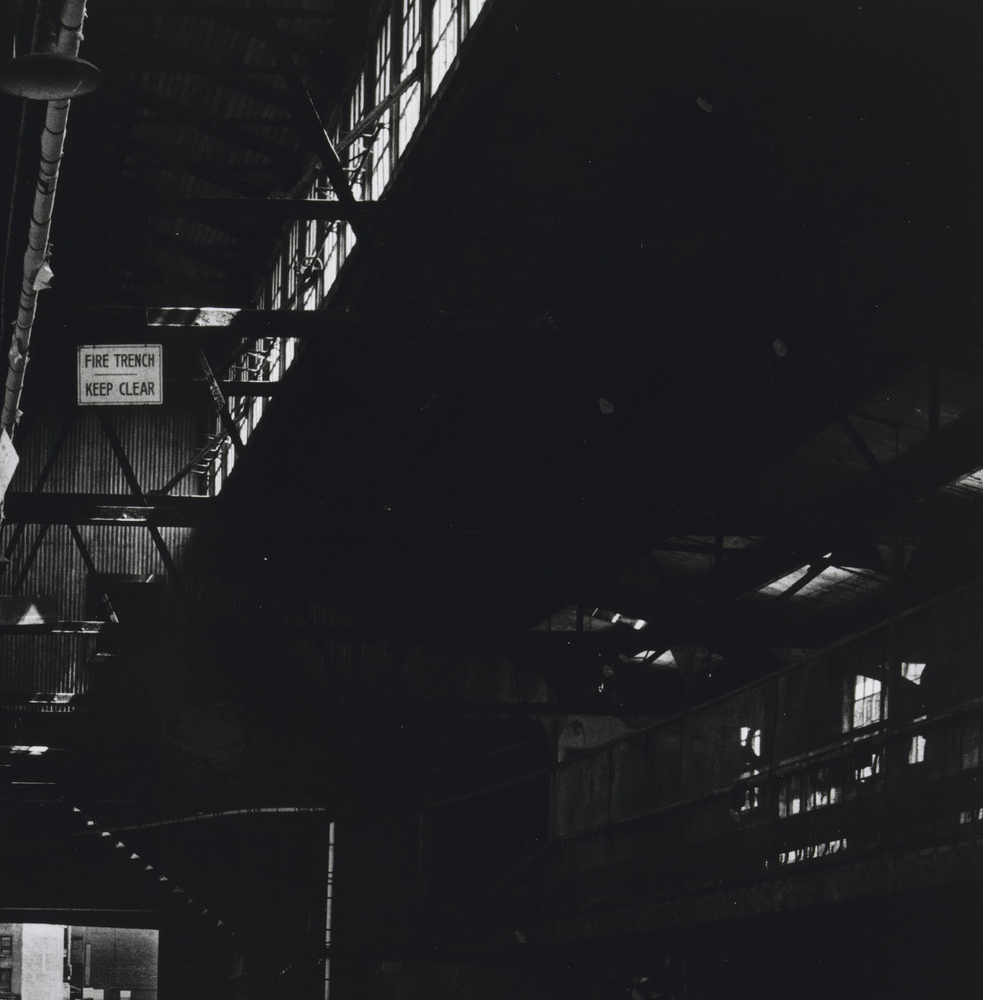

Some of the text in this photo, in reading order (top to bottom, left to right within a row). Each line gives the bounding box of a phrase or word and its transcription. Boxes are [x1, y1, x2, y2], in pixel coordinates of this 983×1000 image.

[85, 353, 155, 368] FIRE TRENCH
[85, 381, 155, 397] KEEP CLEAR
